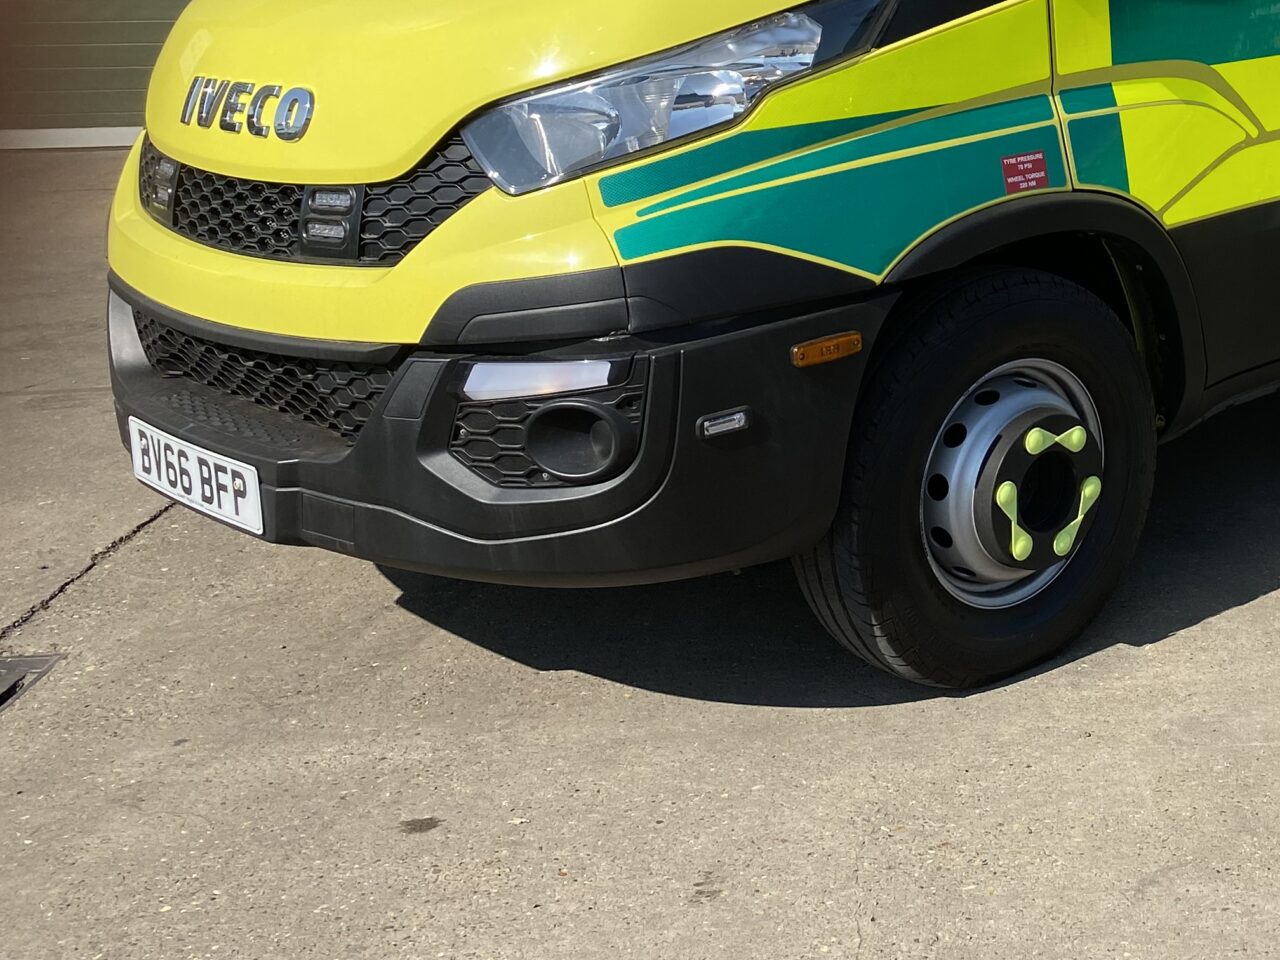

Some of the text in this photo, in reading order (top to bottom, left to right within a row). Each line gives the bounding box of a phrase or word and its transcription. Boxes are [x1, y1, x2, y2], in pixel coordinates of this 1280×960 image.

[180, 76, 315, 143] IVECO
[1003, 152, 1044, 165] TYRE PRESSURE
[1007, 170, 1046, 183] WHEEL TORQUE
[138, 428, 247, 517] BV66 BFP
